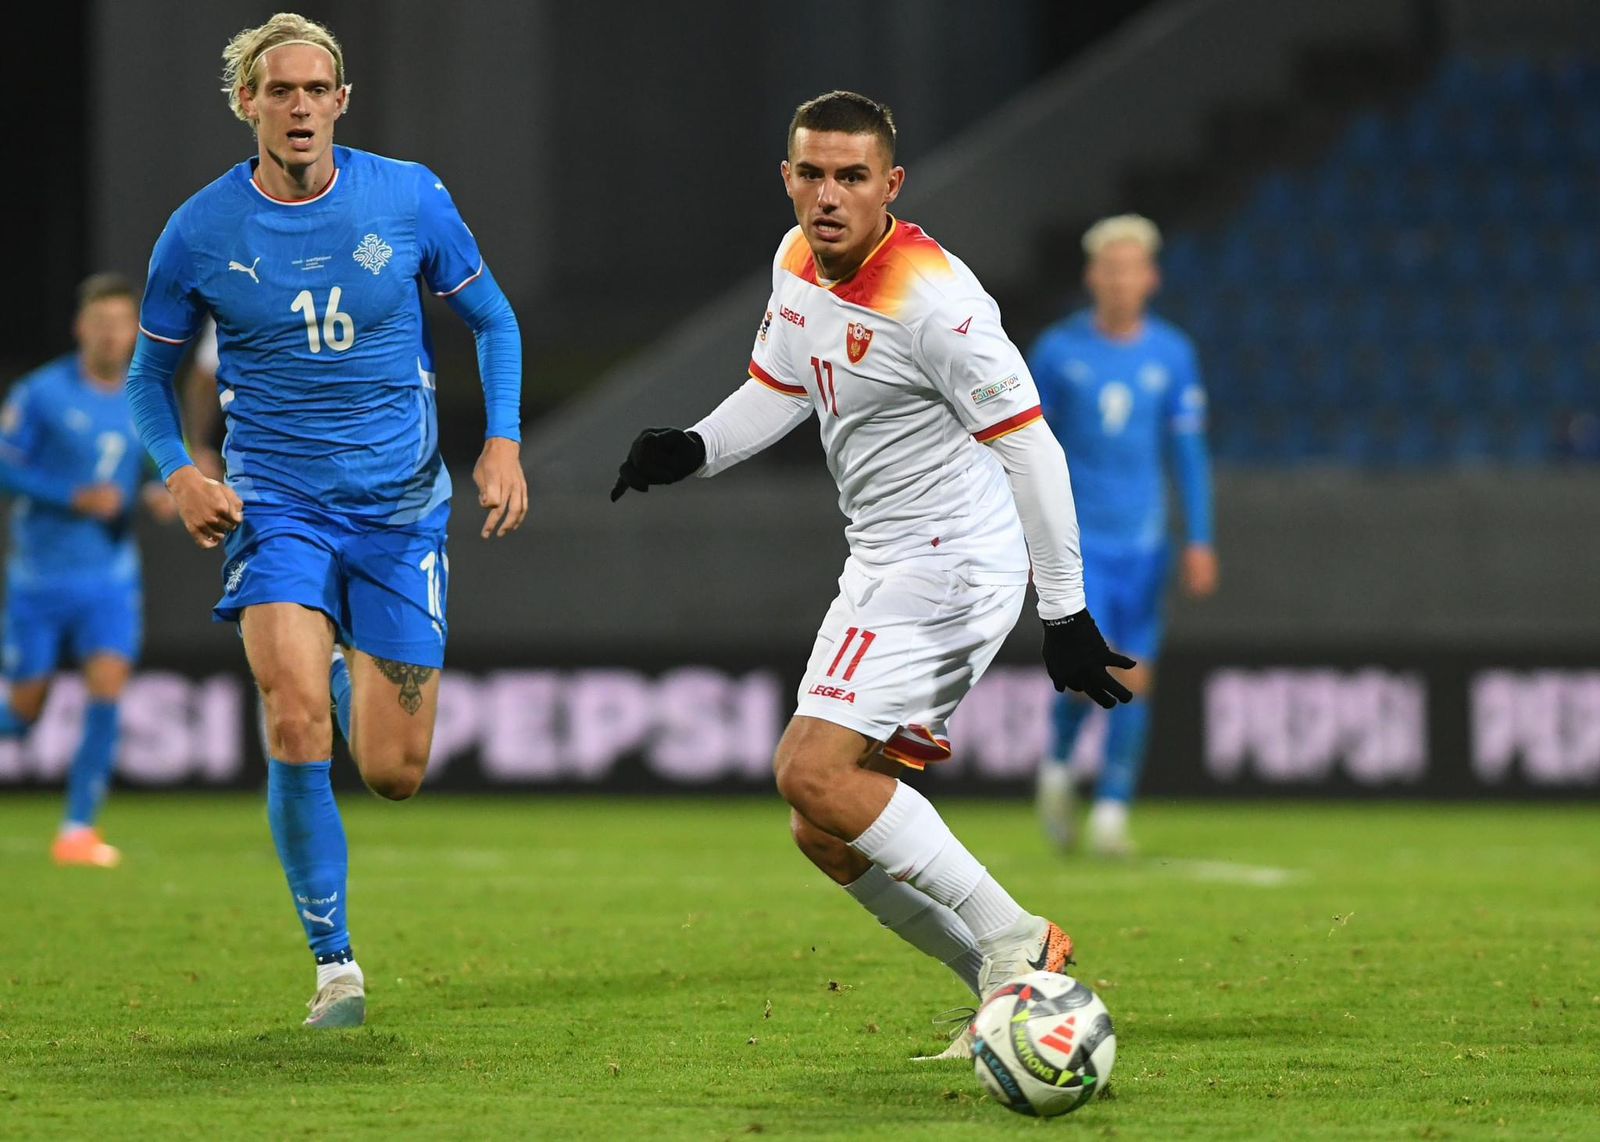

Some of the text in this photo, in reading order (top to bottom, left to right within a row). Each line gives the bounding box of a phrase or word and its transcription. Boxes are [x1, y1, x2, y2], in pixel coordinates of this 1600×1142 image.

[290, 286, 355, 354] 16
[780, 304, 805, 328] LEGEA
[811, 356, 839, 418] 11
[972, 375, 1019, 402] FOUNDATION
[826, 627, 876, 682] 11
[808, 684, 856, 703] LEGEA
[424, 668, 781, 783] PEPSI
[1014, 1026, 1055, 1080] NATIONS
